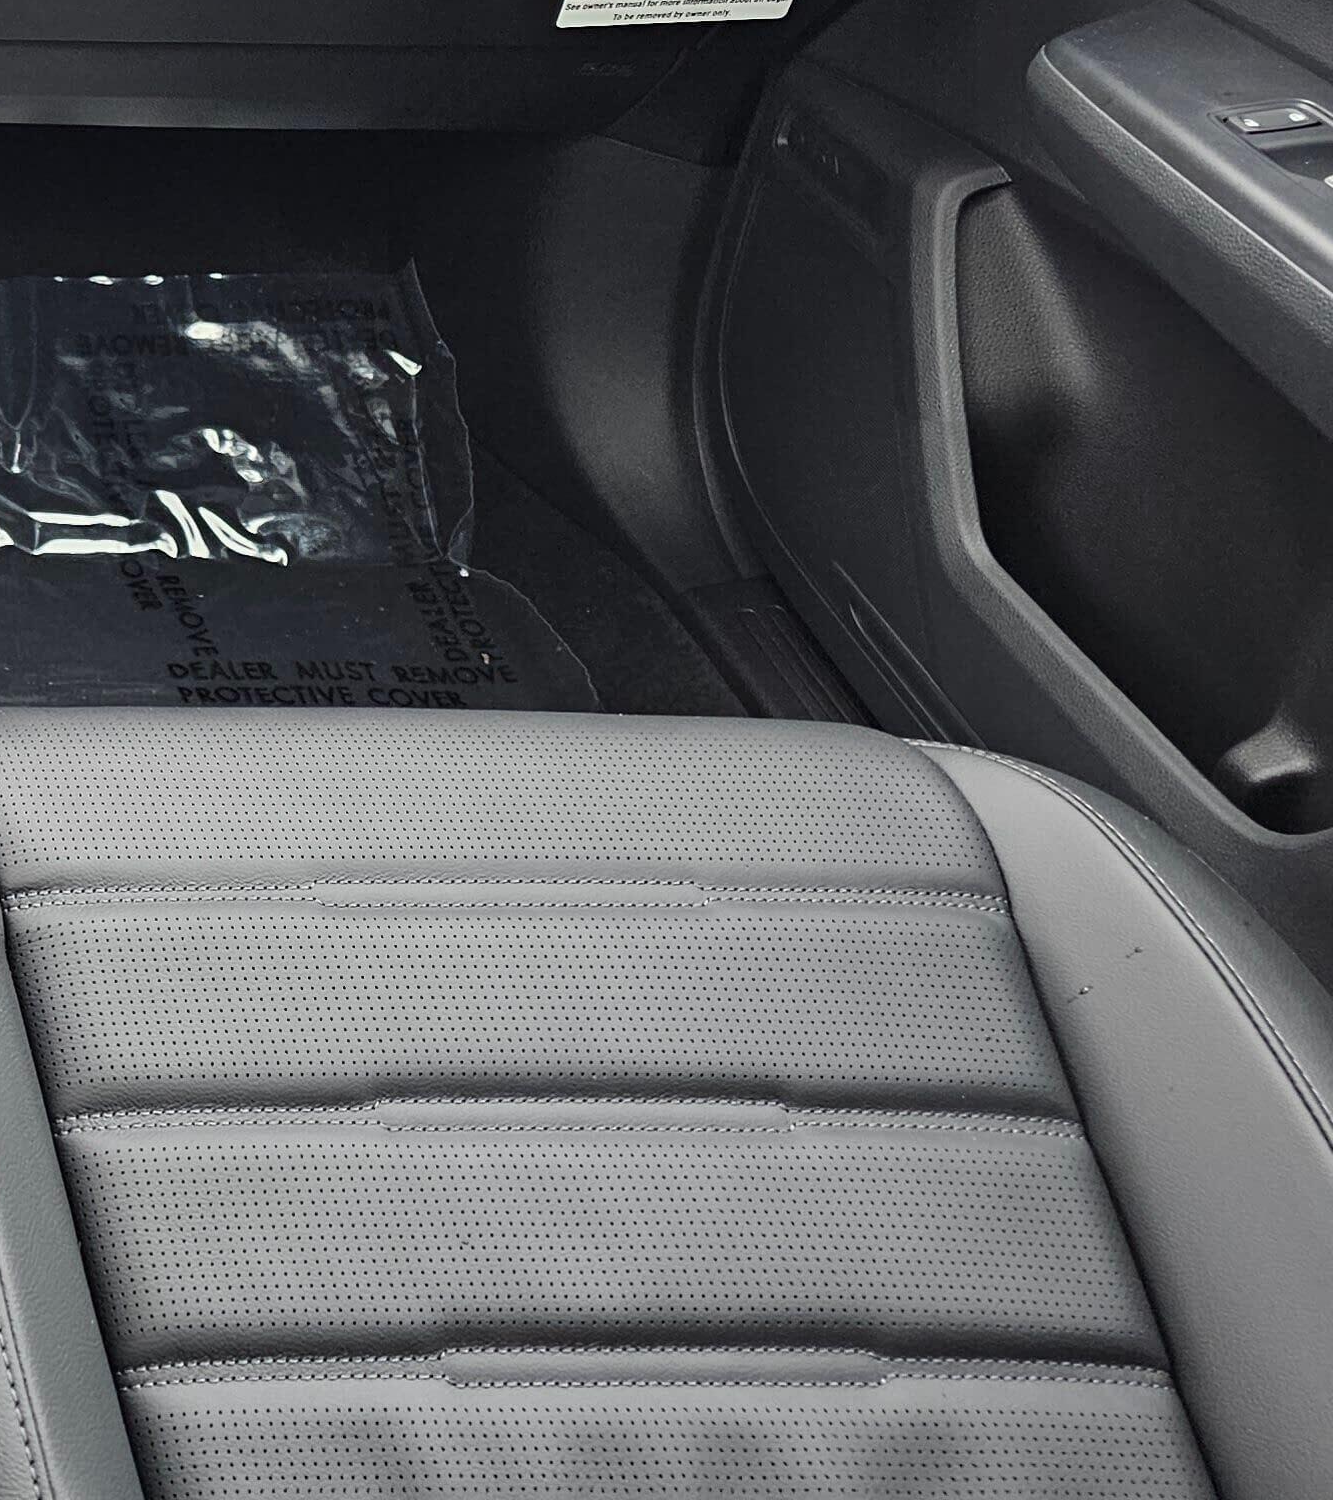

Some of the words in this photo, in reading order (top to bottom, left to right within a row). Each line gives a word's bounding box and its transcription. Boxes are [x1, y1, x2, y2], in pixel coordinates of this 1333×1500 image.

[615, 0, 646, 8] manual
[155, 573, 219, 658] REMOVE
[167, 661, 277, 682] DEALER
[293, 661, 375, 682] MUST
[389, 663, 519, 684] REMOVE
[178, 685, 352, 706] PROTECTIVE
[368, 686, 468, 708] COVER
